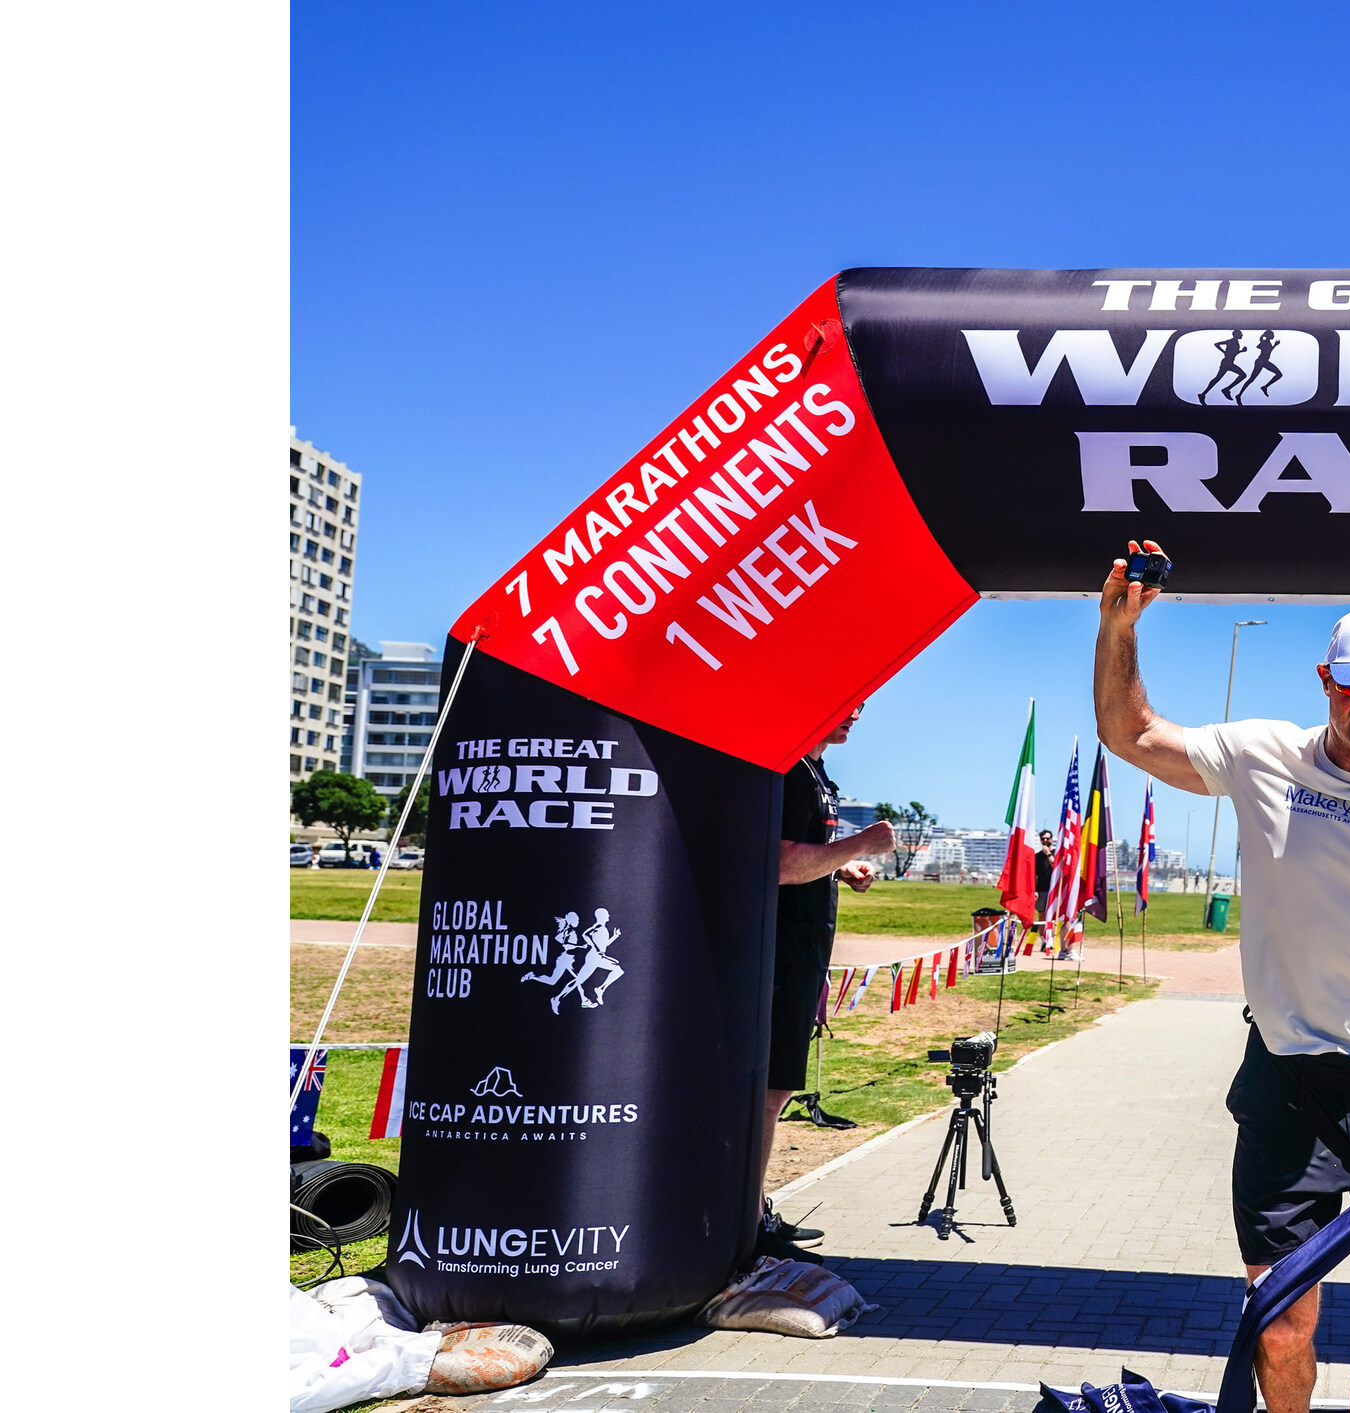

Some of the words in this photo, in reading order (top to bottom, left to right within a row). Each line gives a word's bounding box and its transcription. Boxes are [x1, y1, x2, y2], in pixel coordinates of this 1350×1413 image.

[1091, 279, 1283, 312] THE
[504, 570, 532, 618] 7
[542, 342, 803, 585] MARATHONS
[531, 615, 580, 677] 7
[574, 383, 856, 640] CONTINENTS
[665, 620, 723, 671] 1
[696, 499, 859, 640] WEEK
[456, 738, 502, 760] THE
[507, 738, 620, 760] GREAT
[437, 765, 660, 797] WORLD
[448, 800, 616, 831] RACE
[432, 900, 508, 931] GLOBAL
[429, 934, 549, 965] MARATHON
[427, 967, 472, 998] CLUB
[408, 1100, 426, 1121] ICE
[429, 1103, 466, 1123] CAP
[470, 1103, 639, 1125] ADVENTURES
[425, 1129, 510, 1142] ANTARCTICA
[520, 1131, 588, 1141] AWAITS
[437, 1224, 630, 1257] LUNGEVITY
[436, 1259, 519, 1278] Transforming
[524, 1262, 560, 1278] Lung
[564, 1258, 619, 1273] Cancer
